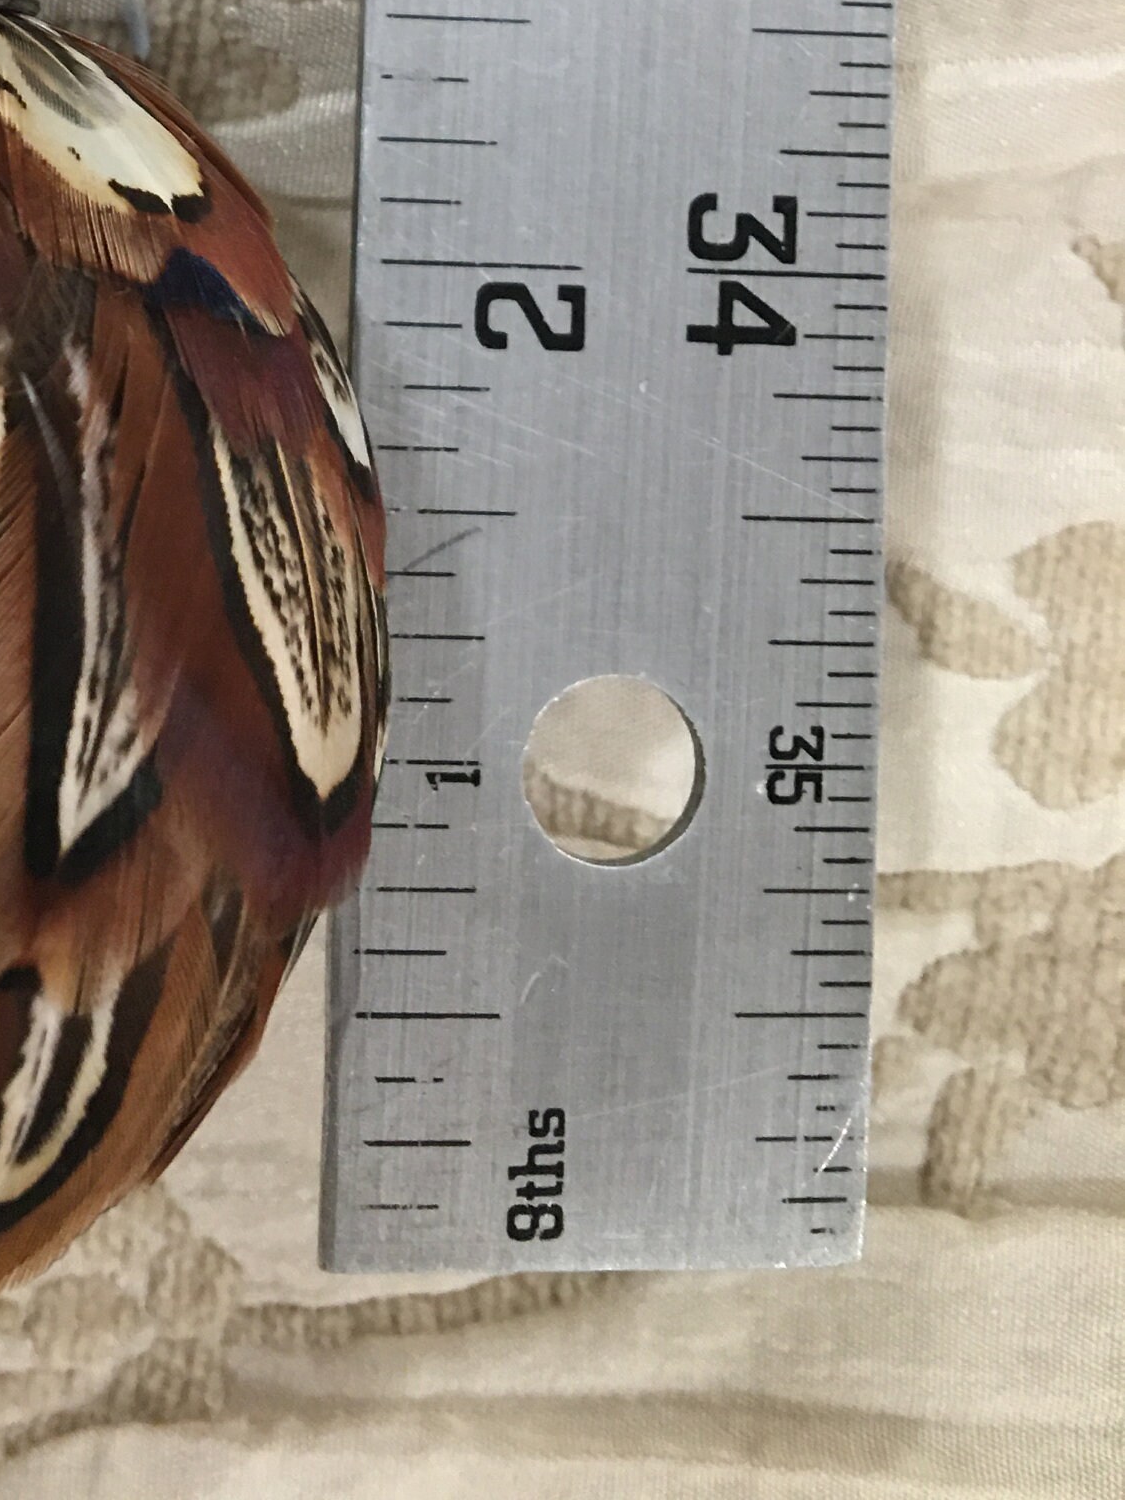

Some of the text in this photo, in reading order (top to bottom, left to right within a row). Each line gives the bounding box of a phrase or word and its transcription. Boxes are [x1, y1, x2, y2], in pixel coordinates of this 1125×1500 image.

[685, 192, 798, 357] 34
[475, 280, 586, 353] 2
[424, 768, 481, 791] 1
[765, 724, 825, 805] 35
[505, 1106, 566, 1242] 8ths
